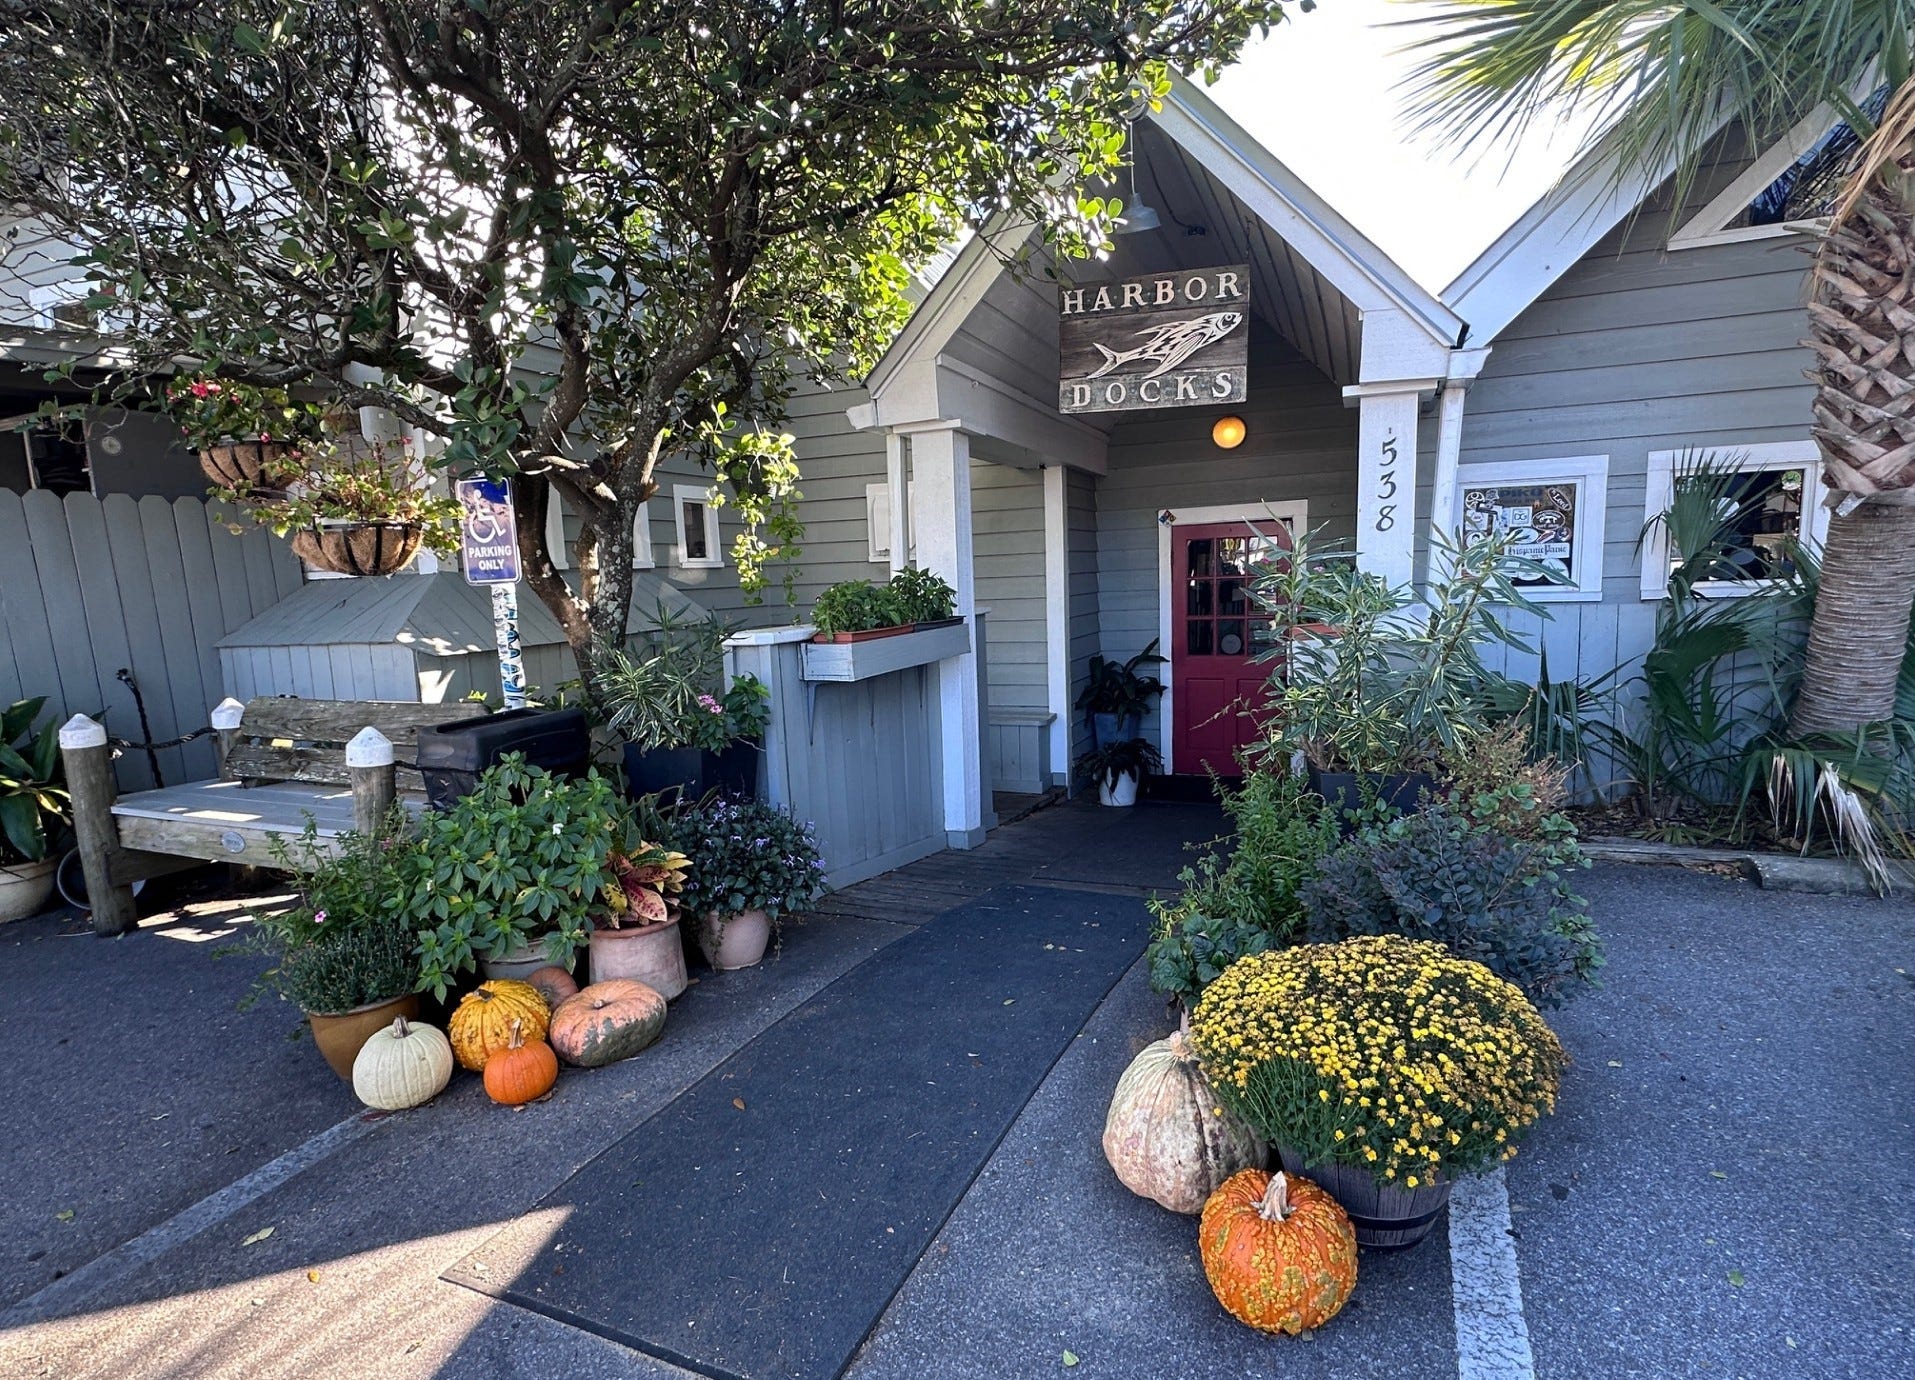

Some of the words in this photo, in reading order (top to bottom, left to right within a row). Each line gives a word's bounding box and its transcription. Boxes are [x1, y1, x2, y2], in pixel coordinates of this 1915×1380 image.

[1061, 272, 1242, 315] HARBOR
[1071, 372, 1233, 408] DOCKS
[1375, 436, 1398, 532] 538
[468, 545, 513, 558] PARKING
[479, 559, 505, 571] ONLY
